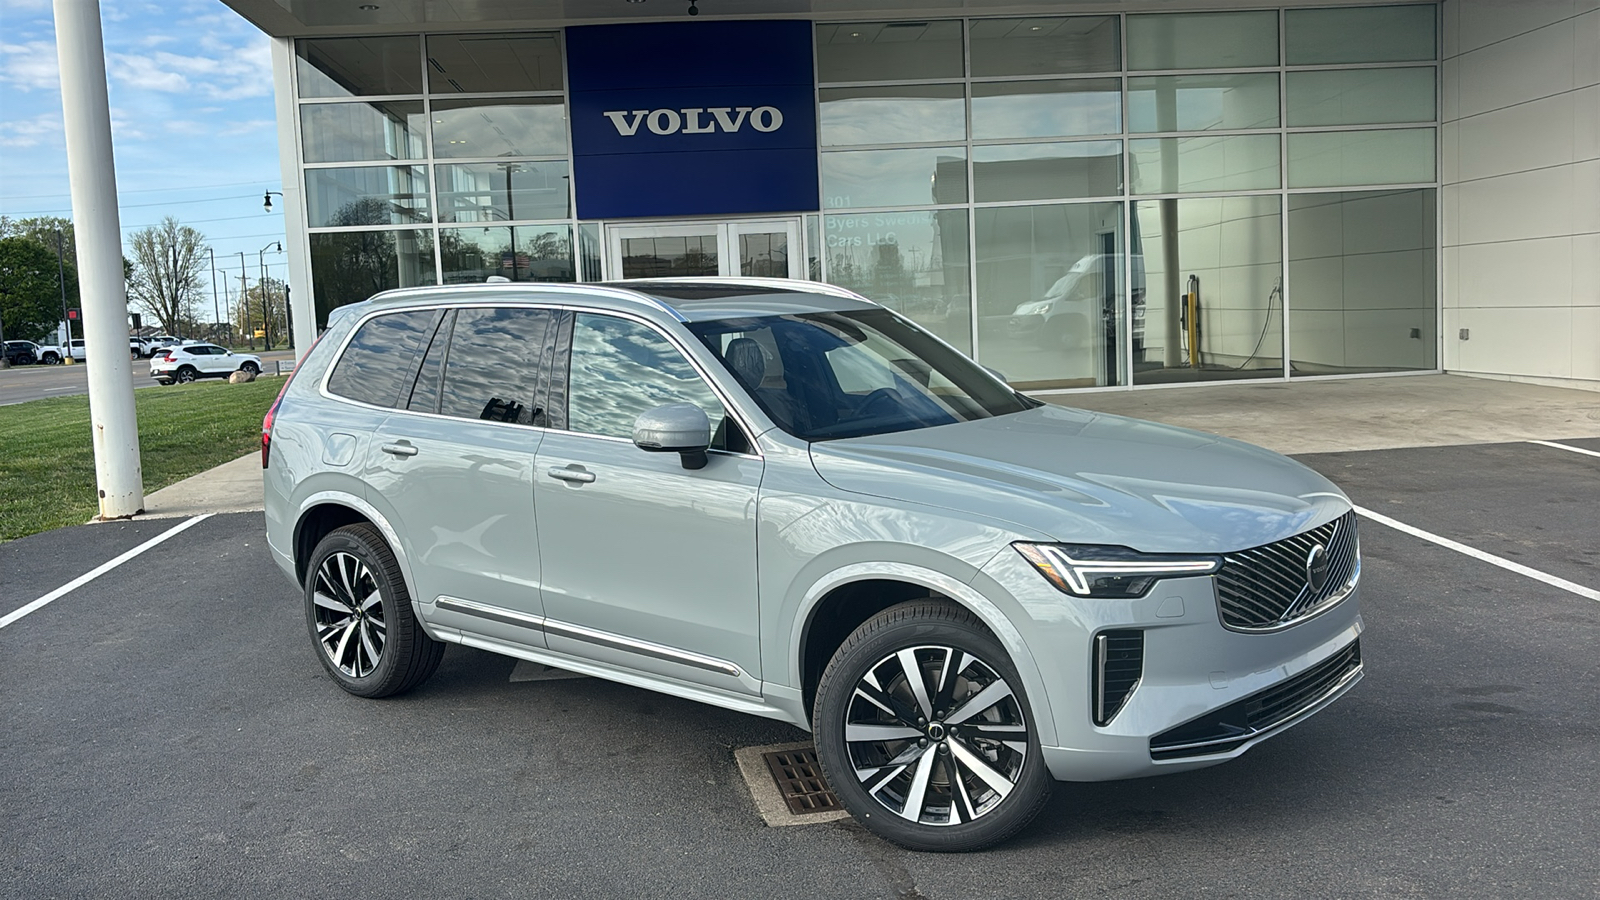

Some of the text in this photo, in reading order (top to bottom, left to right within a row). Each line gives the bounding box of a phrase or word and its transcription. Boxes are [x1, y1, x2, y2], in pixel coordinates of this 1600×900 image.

[603, 106, 784, 136] VOLVO
[826, 196, 851, 208] 301
[827, 217, 869, 232] Byers
[827, 231, 897, 248] Cars LLC
